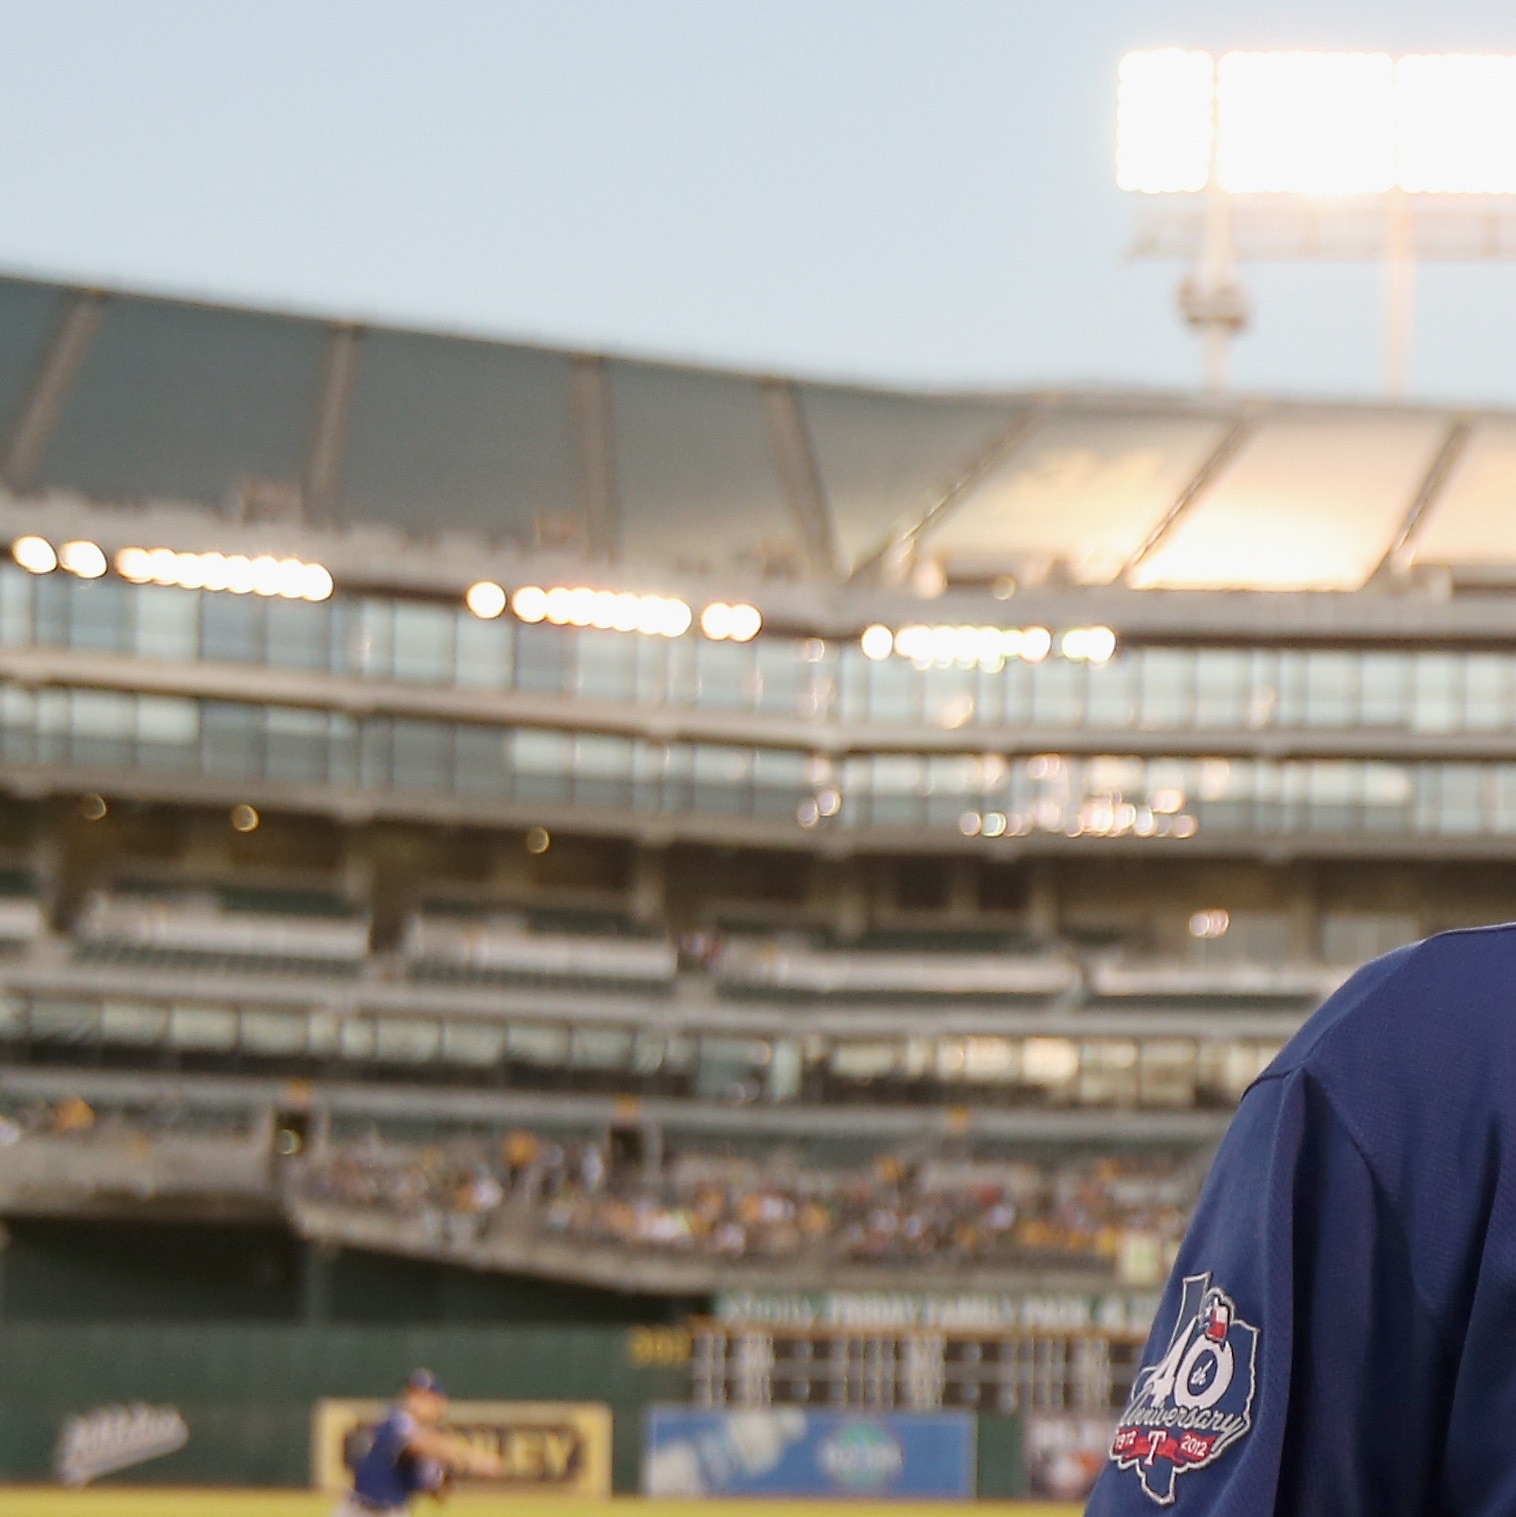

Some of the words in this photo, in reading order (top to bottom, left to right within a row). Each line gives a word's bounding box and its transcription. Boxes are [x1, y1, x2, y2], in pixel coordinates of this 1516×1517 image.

[1144, 1315, 1234, 1410] 40
[1119, 1383, 1246, 1452] Anniversary
[1181, 1435, 1208, 1457] 2012
